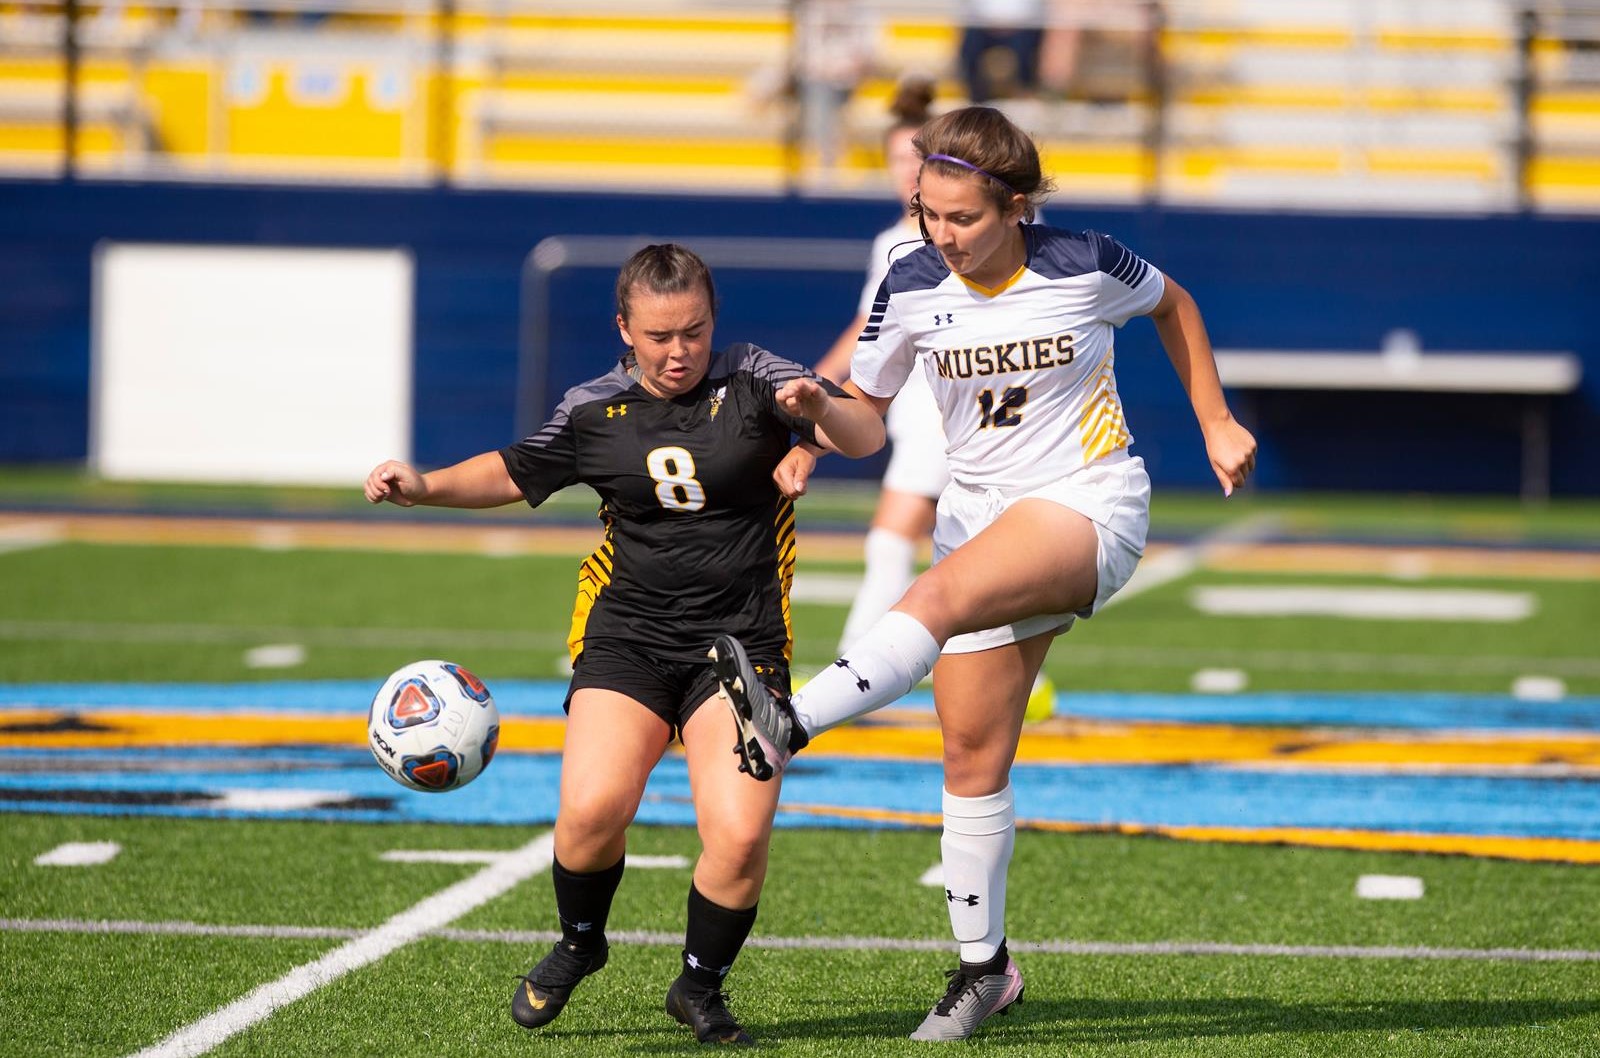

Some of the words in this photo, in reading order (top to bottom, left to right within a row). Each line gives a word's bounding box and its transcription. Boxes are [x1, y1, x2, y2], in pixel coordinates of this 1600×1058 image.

[933, 334, 1075, 380] MUSKIES
[978, 385, 1029, 429] 12
[646, 446, 706, 512] 8
